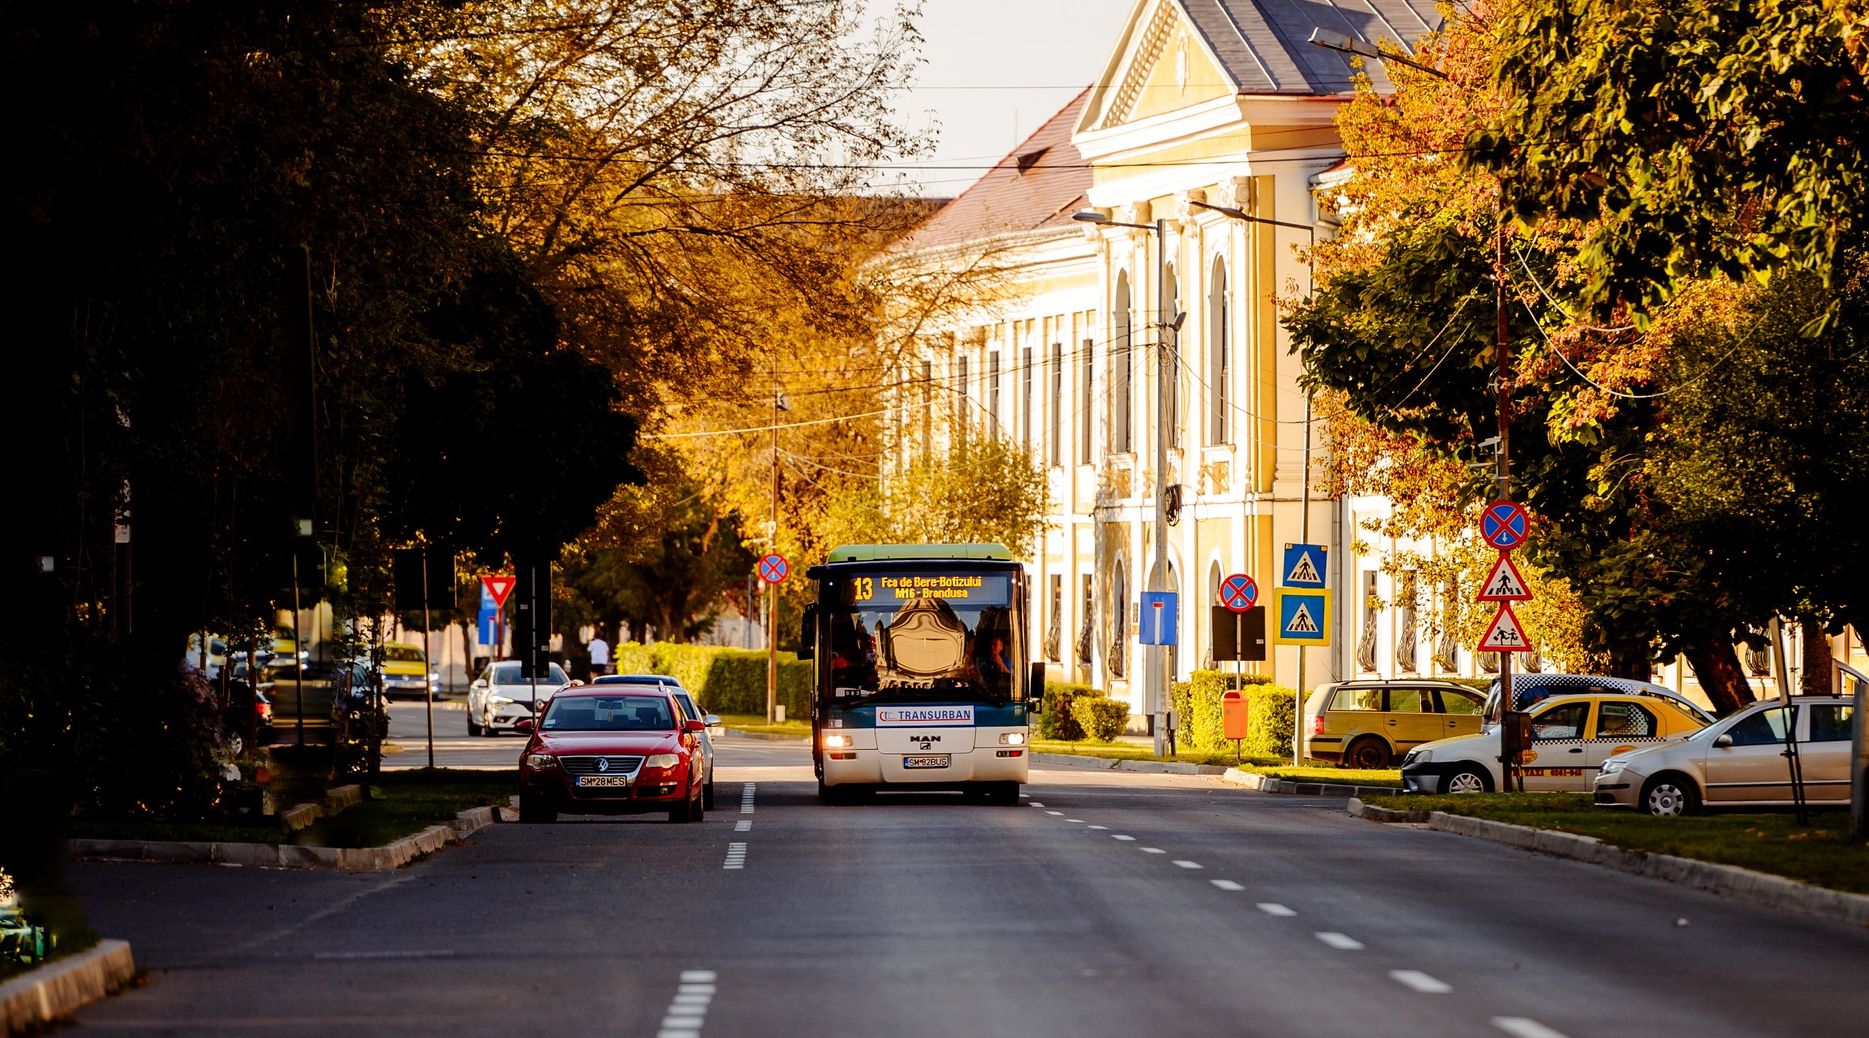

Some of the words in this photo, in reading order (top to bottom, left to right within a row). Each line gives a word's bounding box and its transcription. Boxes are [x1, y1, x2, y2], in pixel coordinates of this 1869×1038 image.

[881, 576, 898, 588] Fca
[900, 576, 912, 587] de
[914, 576, 982, 587] Bere-Botizului
[854, 577, 873, 600] 13
[895, 588, 915, 599] M16
[922, 588, 968, 598] Brandusa
[899, 710, 971, 720] TRANSURBAN
